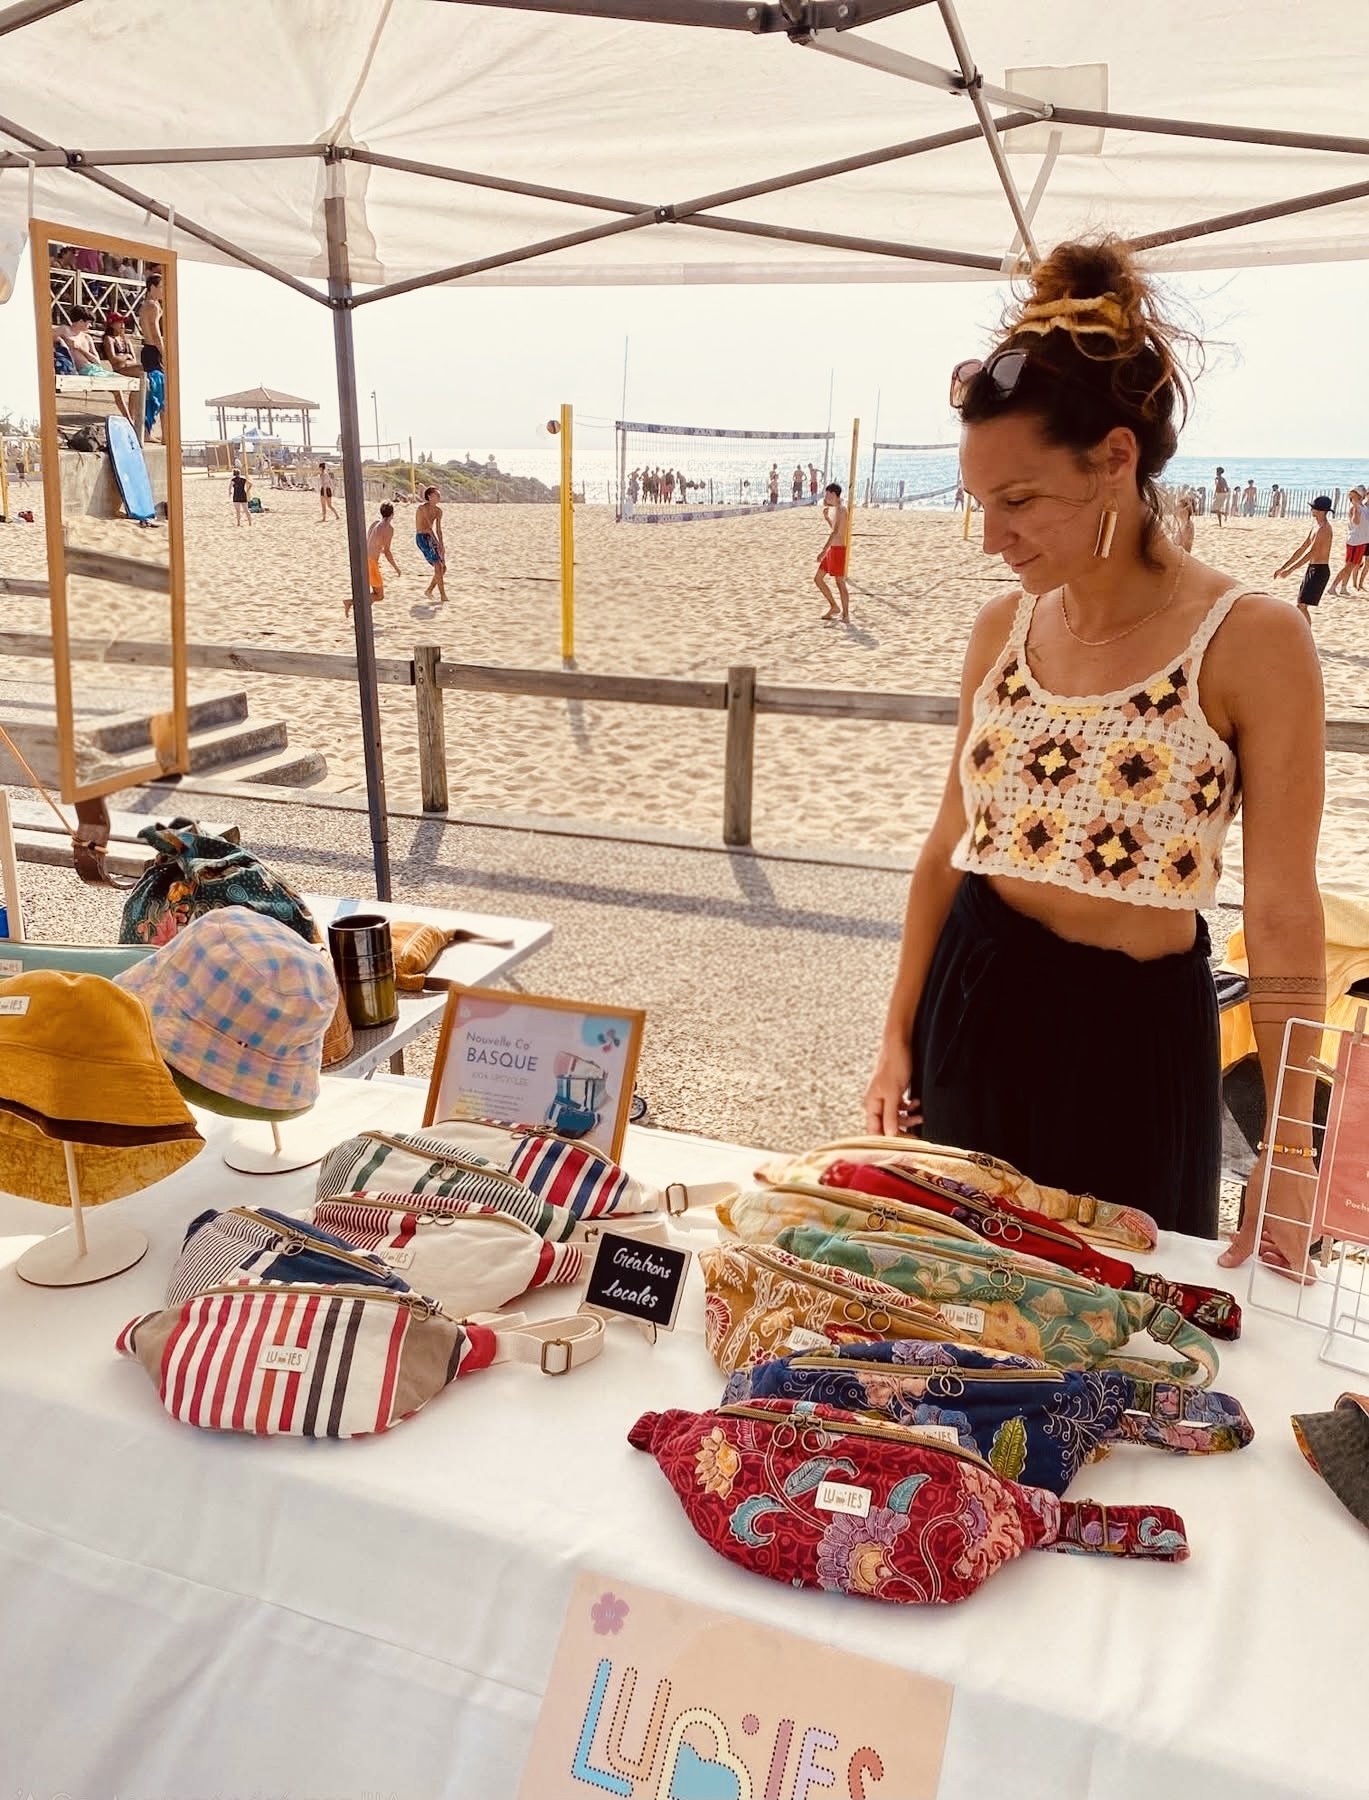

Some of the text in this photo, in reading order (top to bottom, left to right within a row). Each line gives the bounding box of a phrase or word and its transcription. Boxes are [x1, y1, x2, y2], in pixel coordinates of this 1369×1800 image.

[466, 1032, 512, 1048] Nouvelle
[466, 1047, 539, 1072] BASQUE
[945, 1309, 979, 1327] LUIES
[265, 1351, 303, 1366] LUIES
[823, 1487, 864, 1509] LUIES
